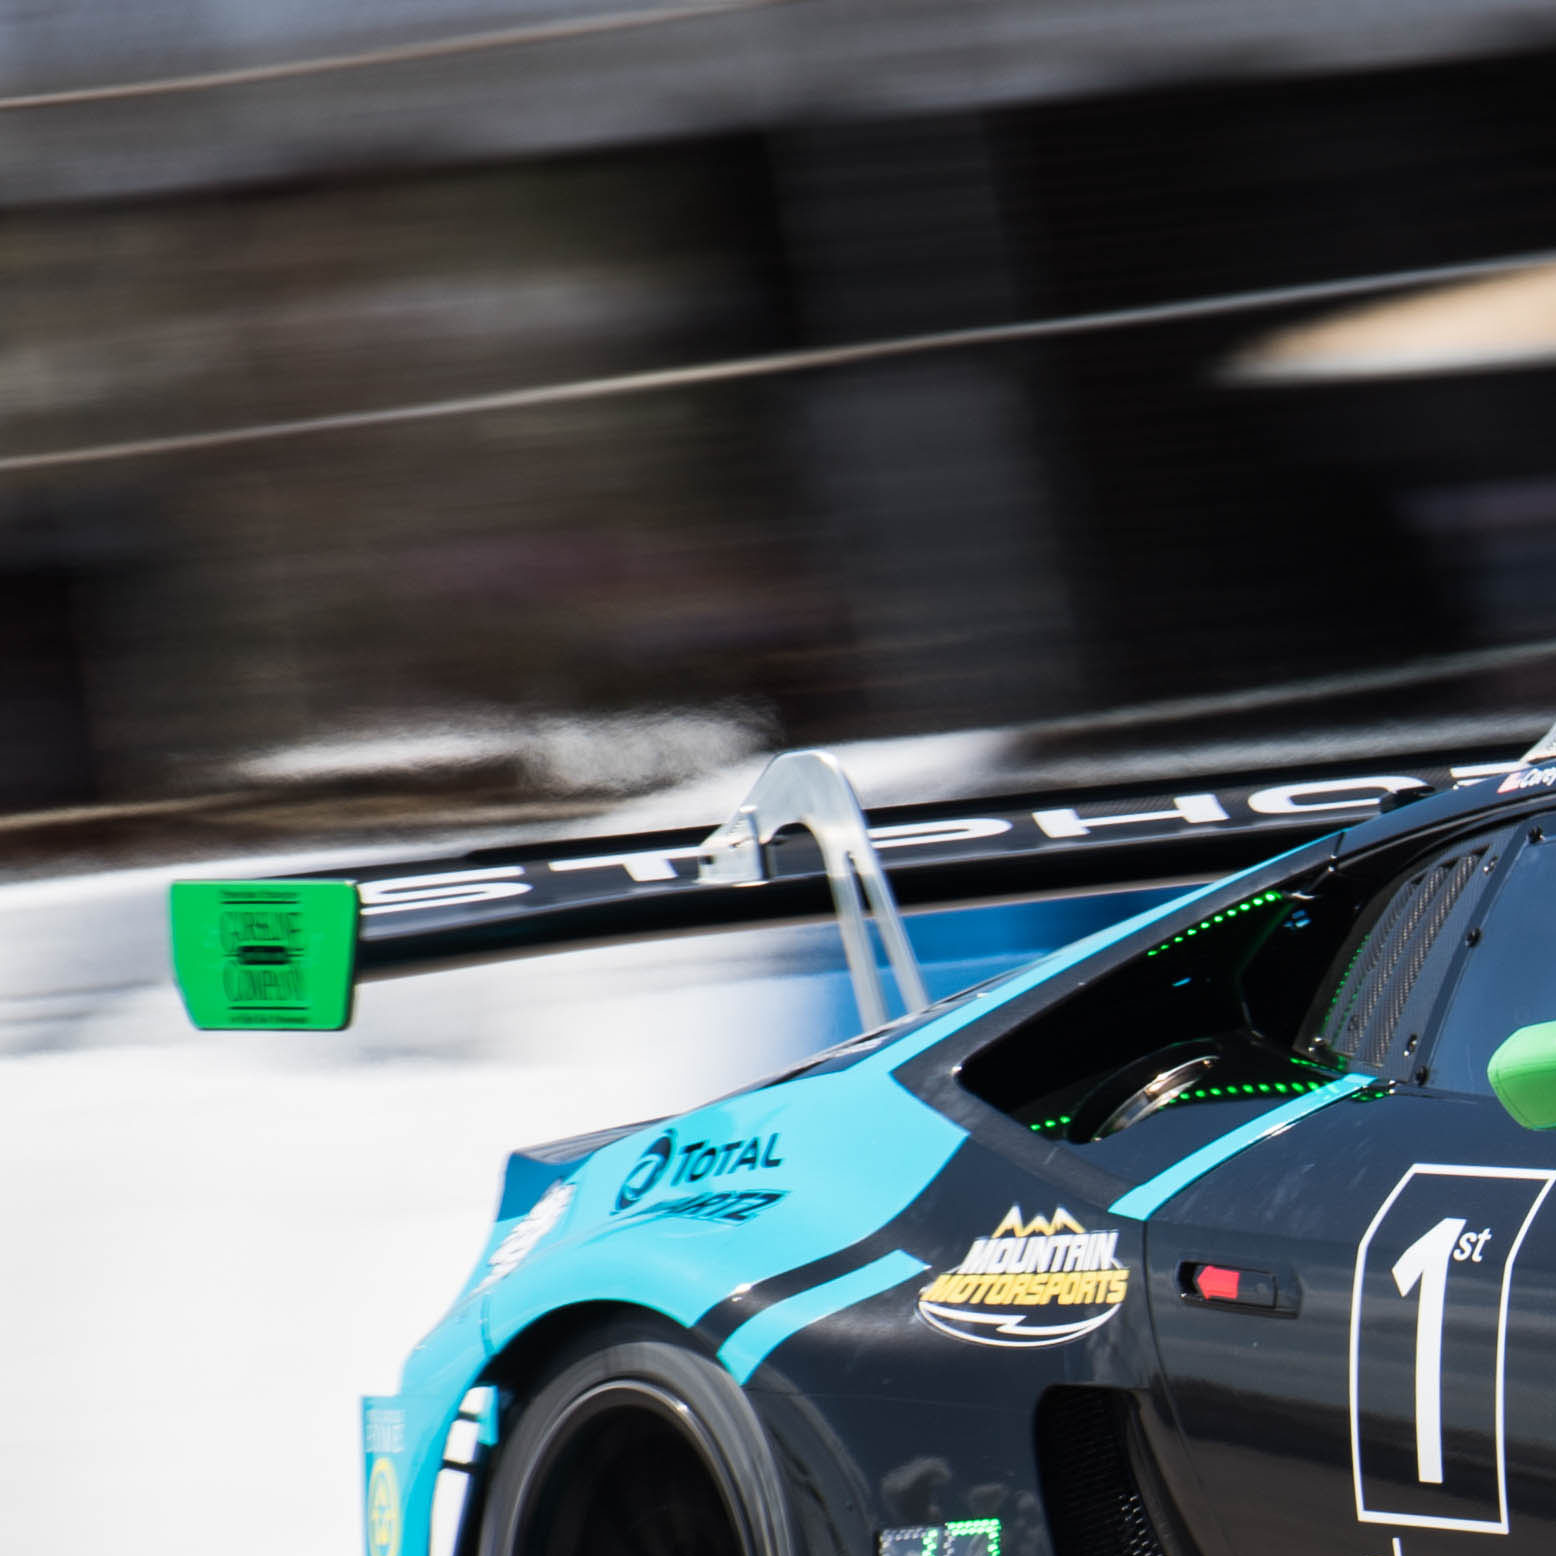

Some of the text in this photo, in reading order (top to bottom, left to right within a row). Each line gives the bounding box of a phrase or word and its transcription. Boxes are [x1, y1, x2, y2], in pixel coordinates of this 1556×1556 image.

[669, 1131, 784, 1187] TOTAL
[959, 1229, 1129, 1275] MOUNTAIN
[919, 1268, 1131, 1306] MOTORSPORTS
